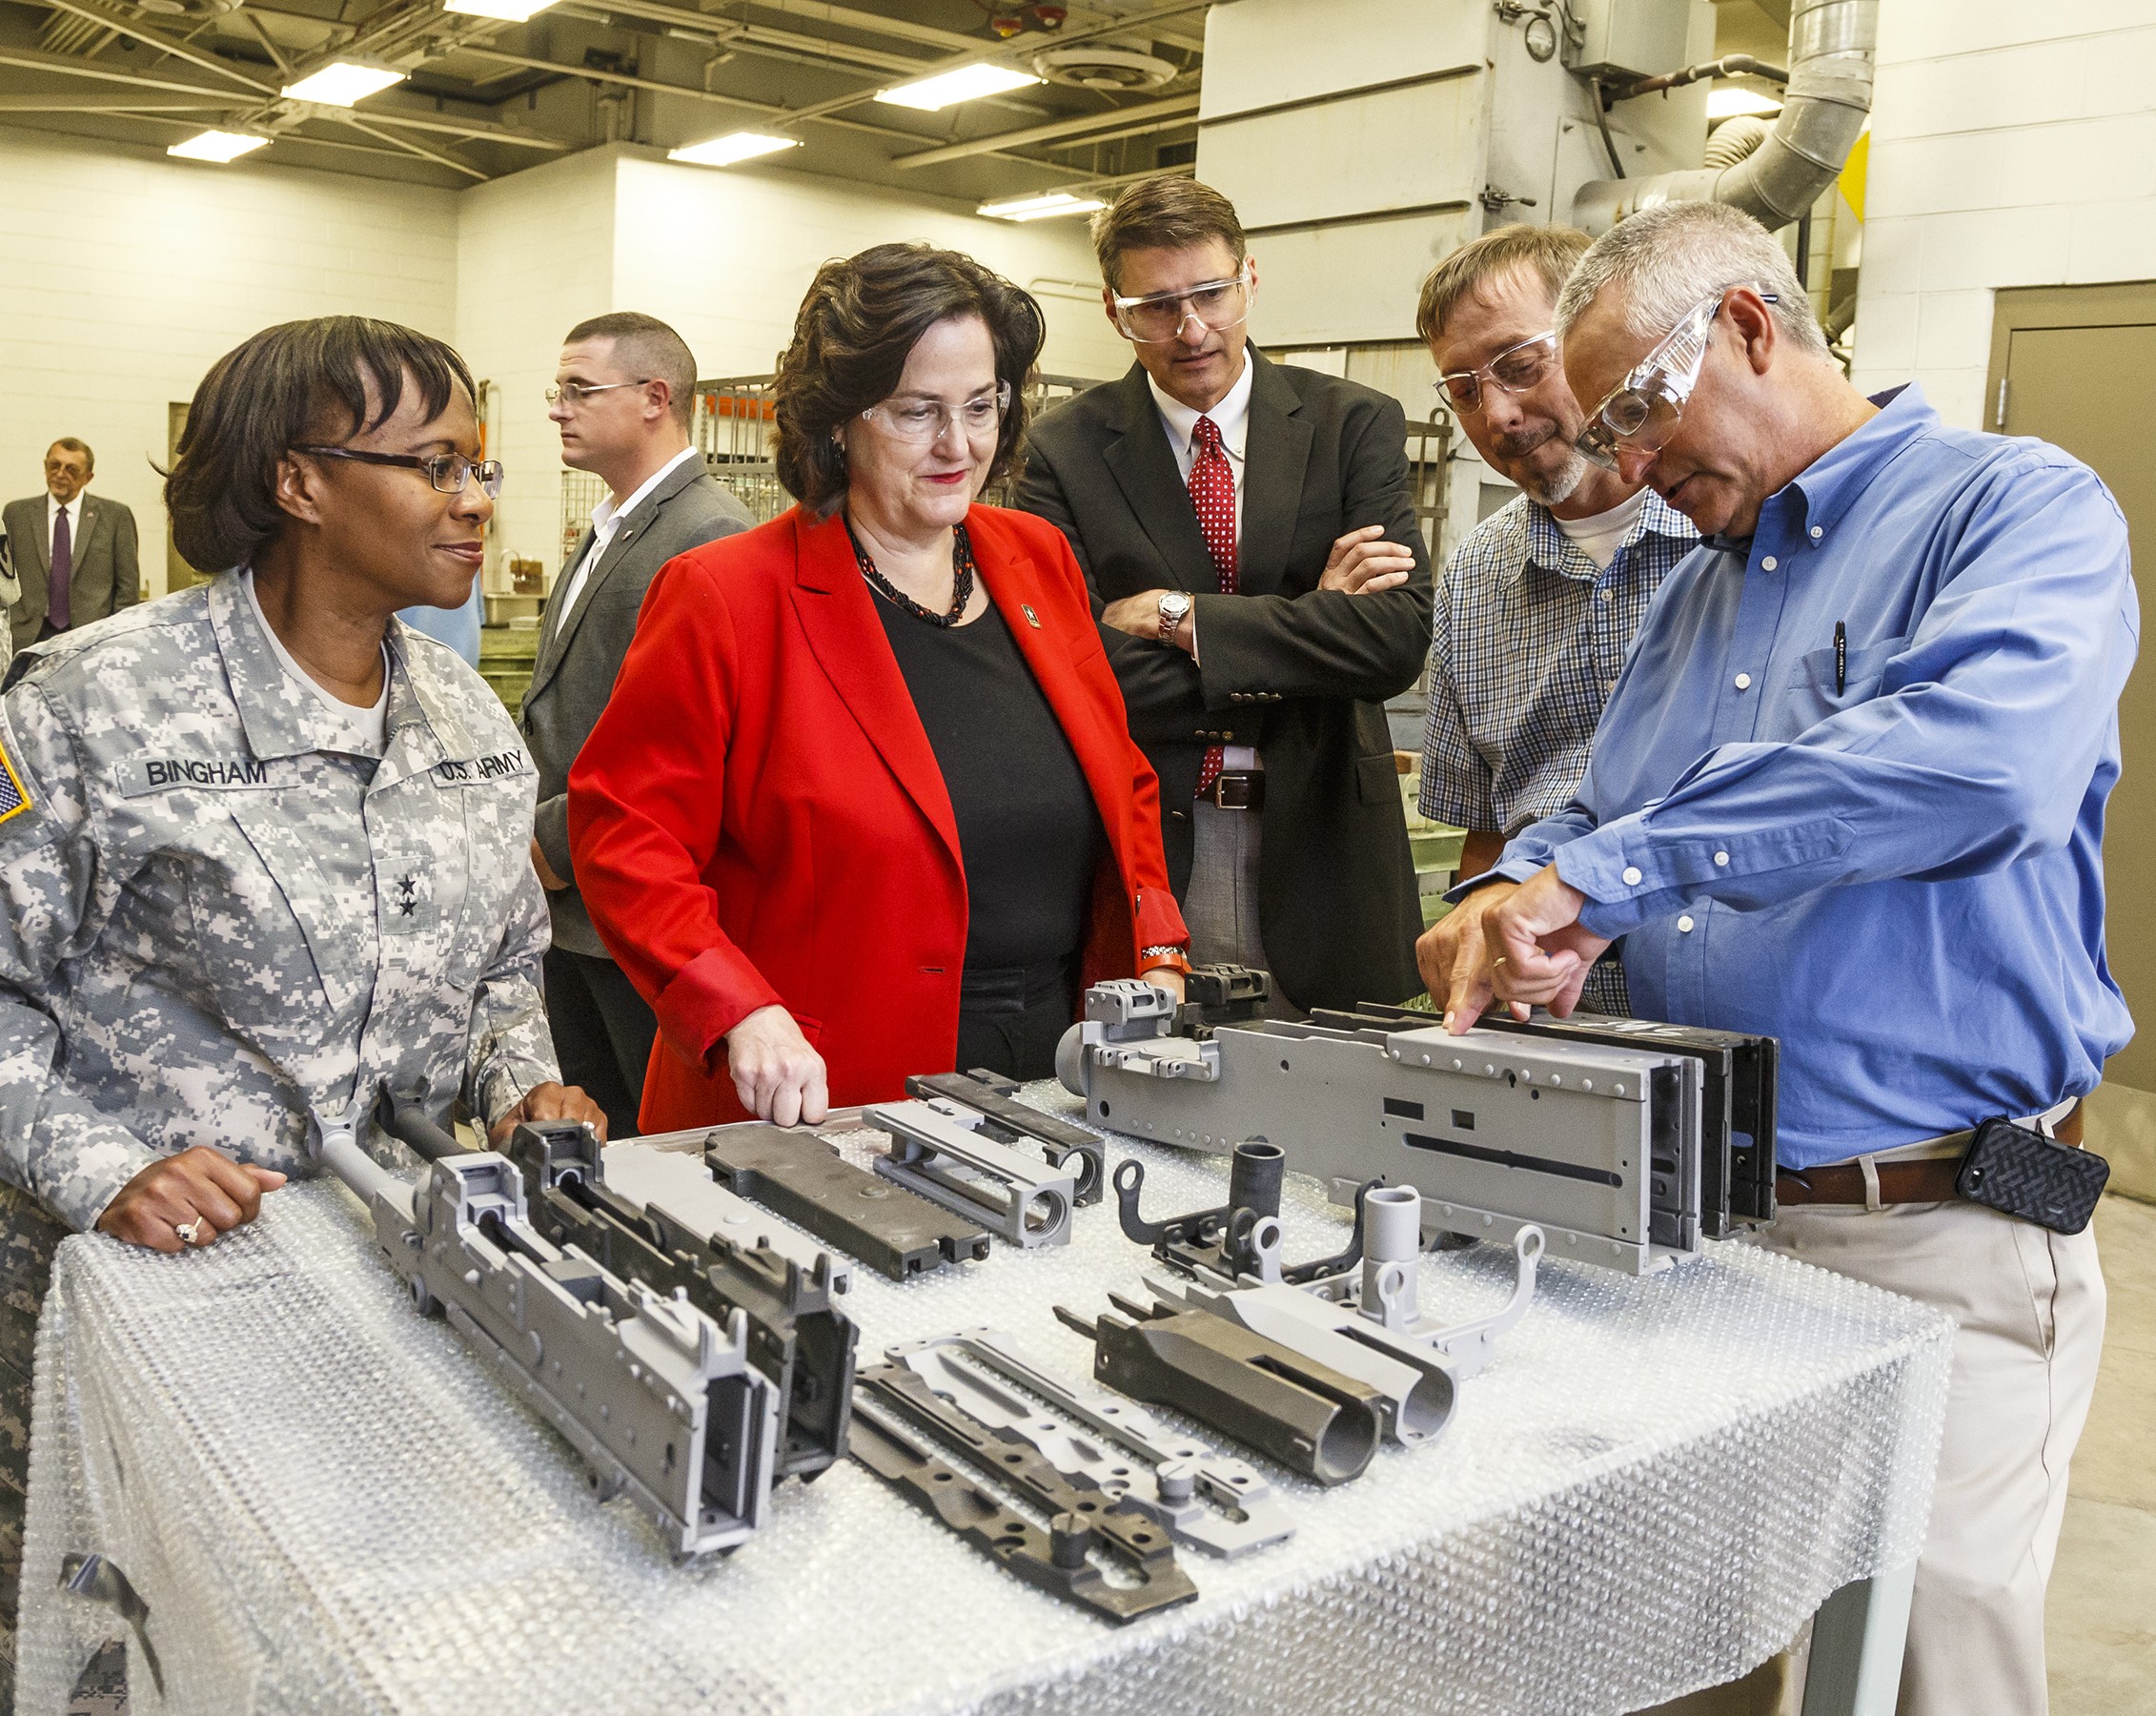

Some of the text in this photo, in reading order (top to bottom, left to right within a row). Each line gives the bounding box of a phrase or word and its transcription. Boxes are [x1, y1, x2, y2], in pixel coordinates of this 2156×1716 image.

[146, 759, 268, 786] BINGHAM
[438, 749, 524, 781] U.S. ARMY
